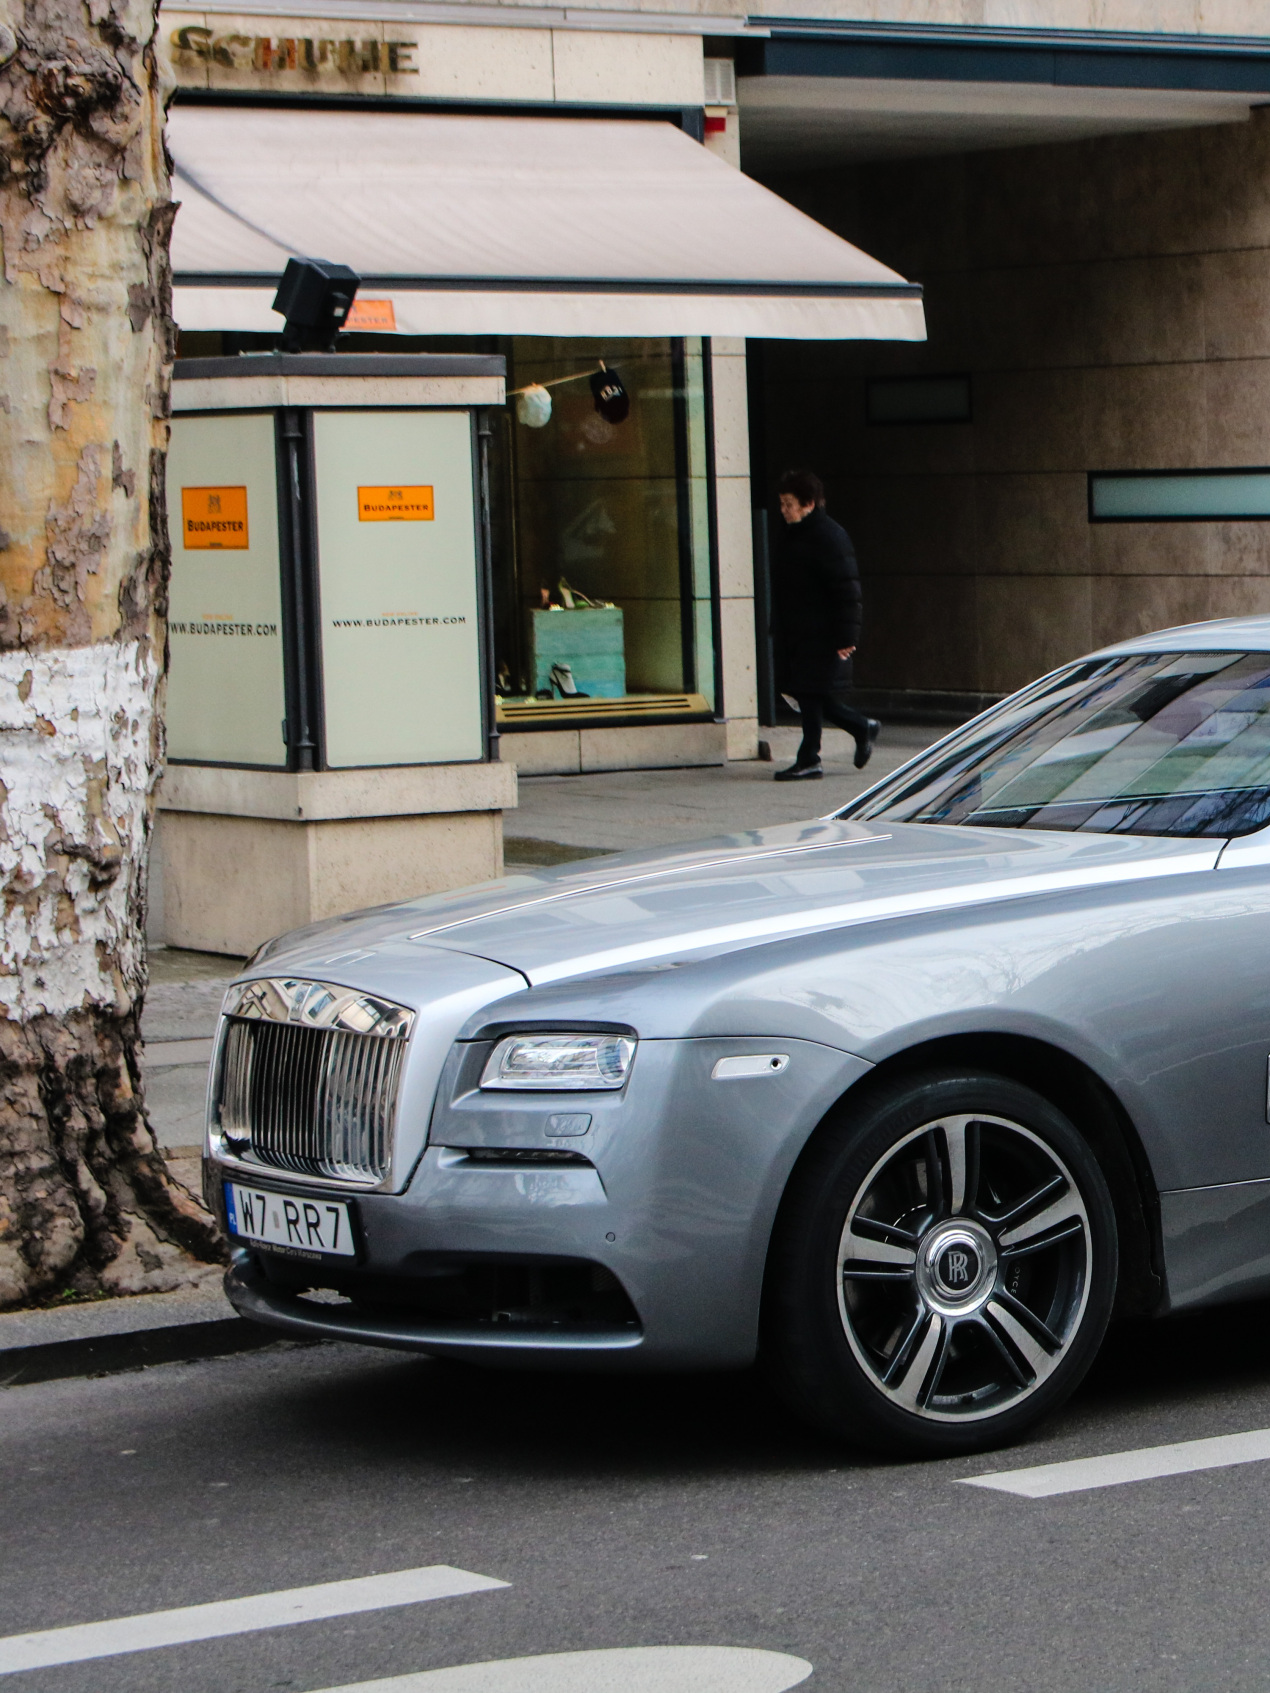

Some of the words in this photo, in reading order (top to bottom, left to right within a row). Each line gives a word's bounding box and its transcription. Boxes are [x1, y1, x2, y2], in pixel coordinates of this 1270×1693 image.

[363, 504, 429, 512] BUDAPESTER
[187, 520, 244, 532] BUDAPESTER
[332, 616, 466, 628] WWW.BUDAPESTER.COM
[239, 1189, 266, 1237] W7
[282, 1199, 340, 1249] RR7
[947, 1250, 968, 1283] RR
